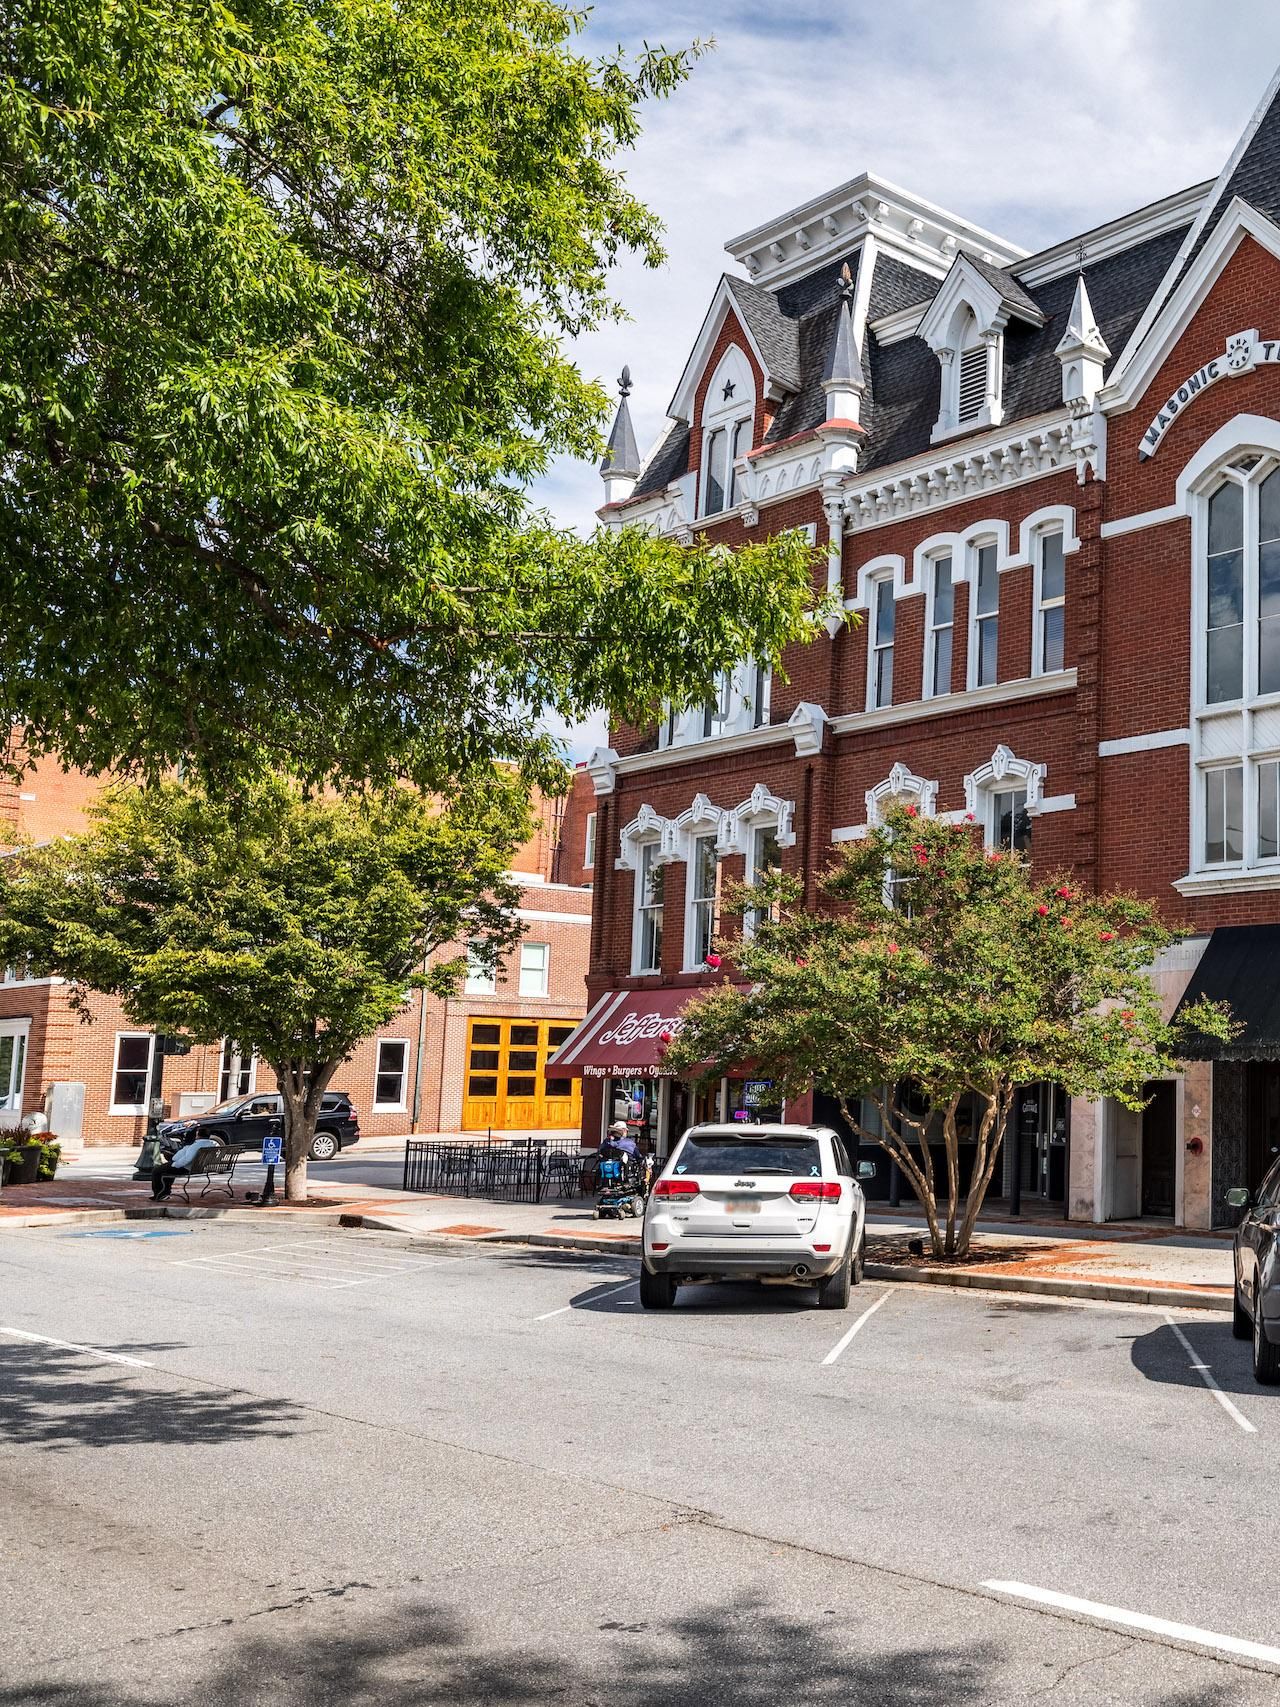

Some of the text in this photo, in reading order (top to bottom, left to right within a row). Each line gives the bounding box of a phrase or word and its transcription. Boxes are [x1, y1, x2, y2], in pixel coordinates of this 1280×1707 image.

[1144, 361, 1220, 446] MASONIC
[583, 1065, 606, 1078] Wings
[612, 1065, 642, 1078] Burgers
[734, 1180, 756, 1189] Jeep
